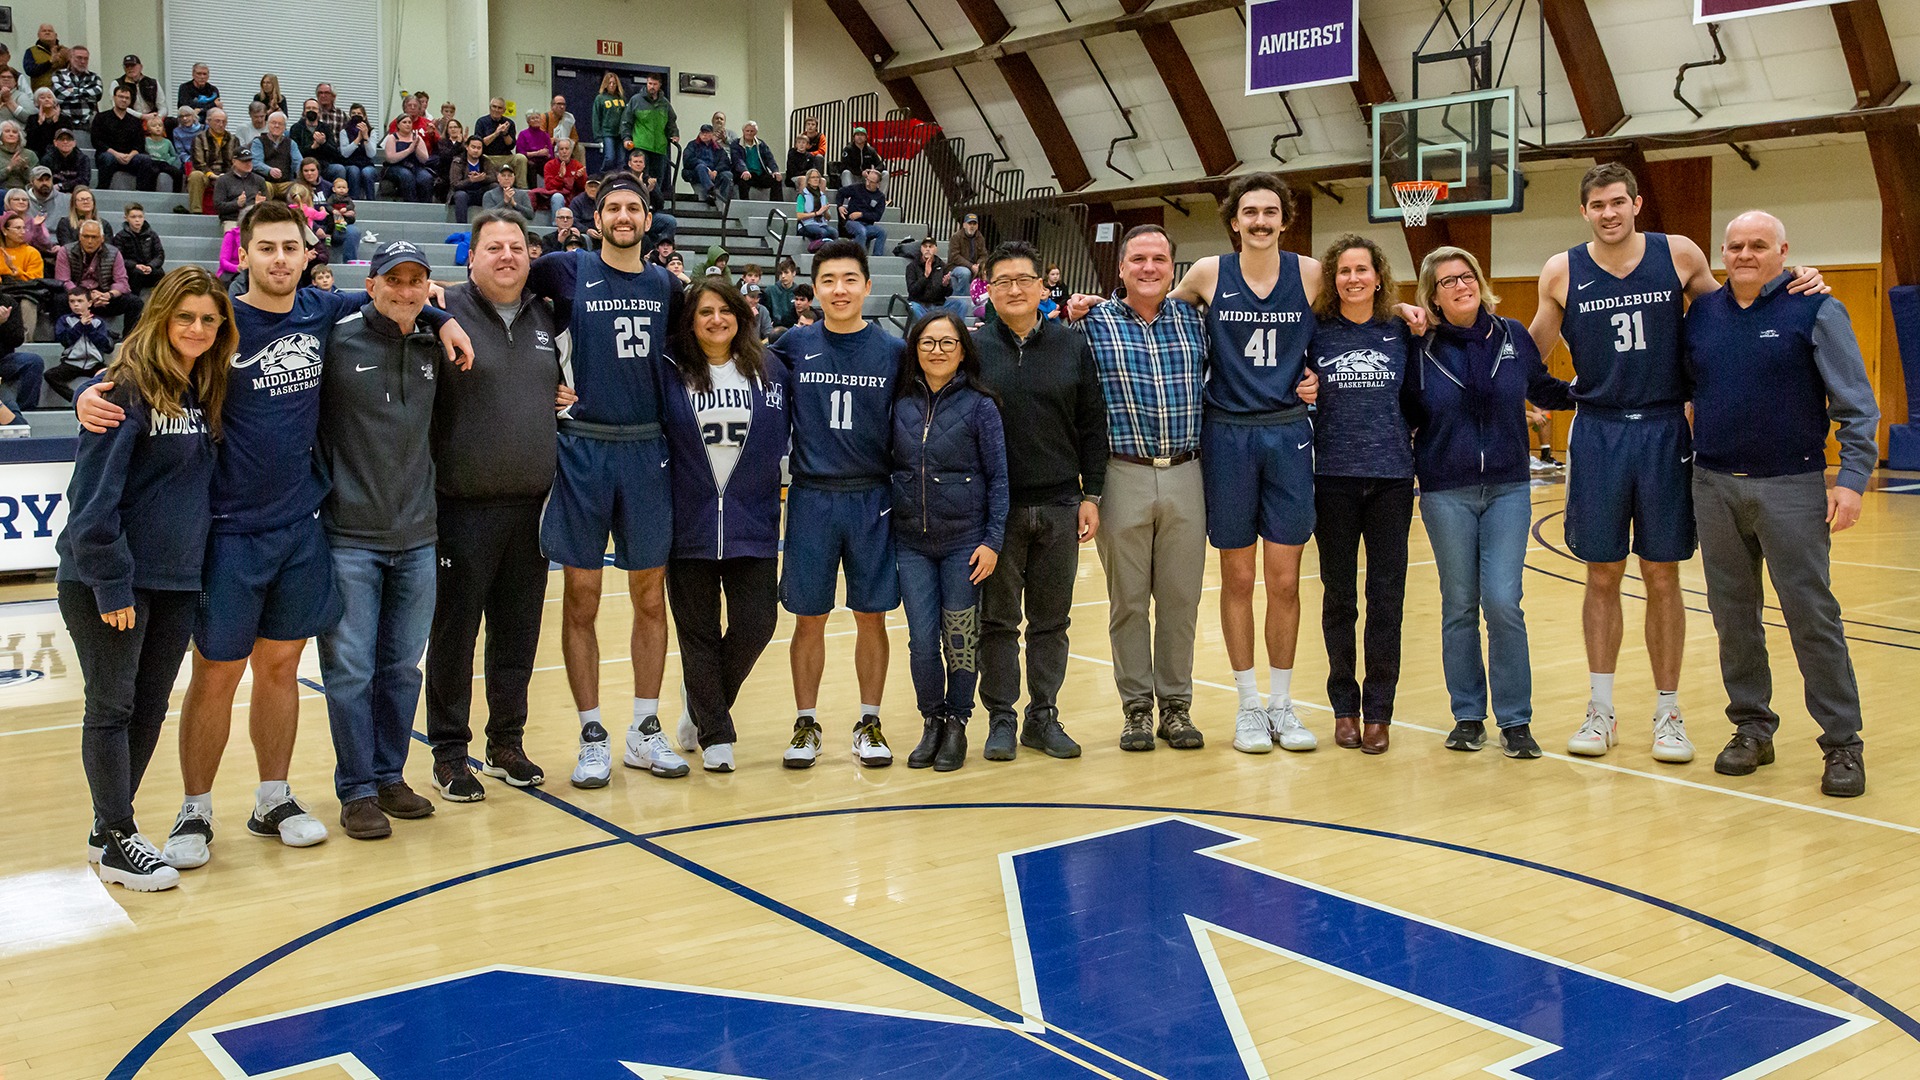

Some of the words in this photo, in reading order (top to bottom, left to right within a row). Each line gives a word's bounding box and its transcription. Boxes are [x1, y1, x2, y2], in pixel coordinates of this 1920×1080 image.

[602, 41, 619, 55] EXIT
[1258, 22, 1345, 56] AMHERST
[585, 299, 664, 313] MIDDLEBUR
[1578, 290, 1672, 314] MIDDLEBURY
[1218, 310, 1303, 323] MIDDLEBURY
[613, 316, 651, 359] 25
[1610, 310, 1647, 353] 31
[1244, 328, 1278, 367] 41
[799, 372, 887, 388] MIDDLEBURY
[1327, 371, 1396, 383] MIDDLEBURY
[1338, 380, 1386, 389] BASKETBALL
[829, 390, 853, 430] 11
[702, 421, 748, 448] 25
